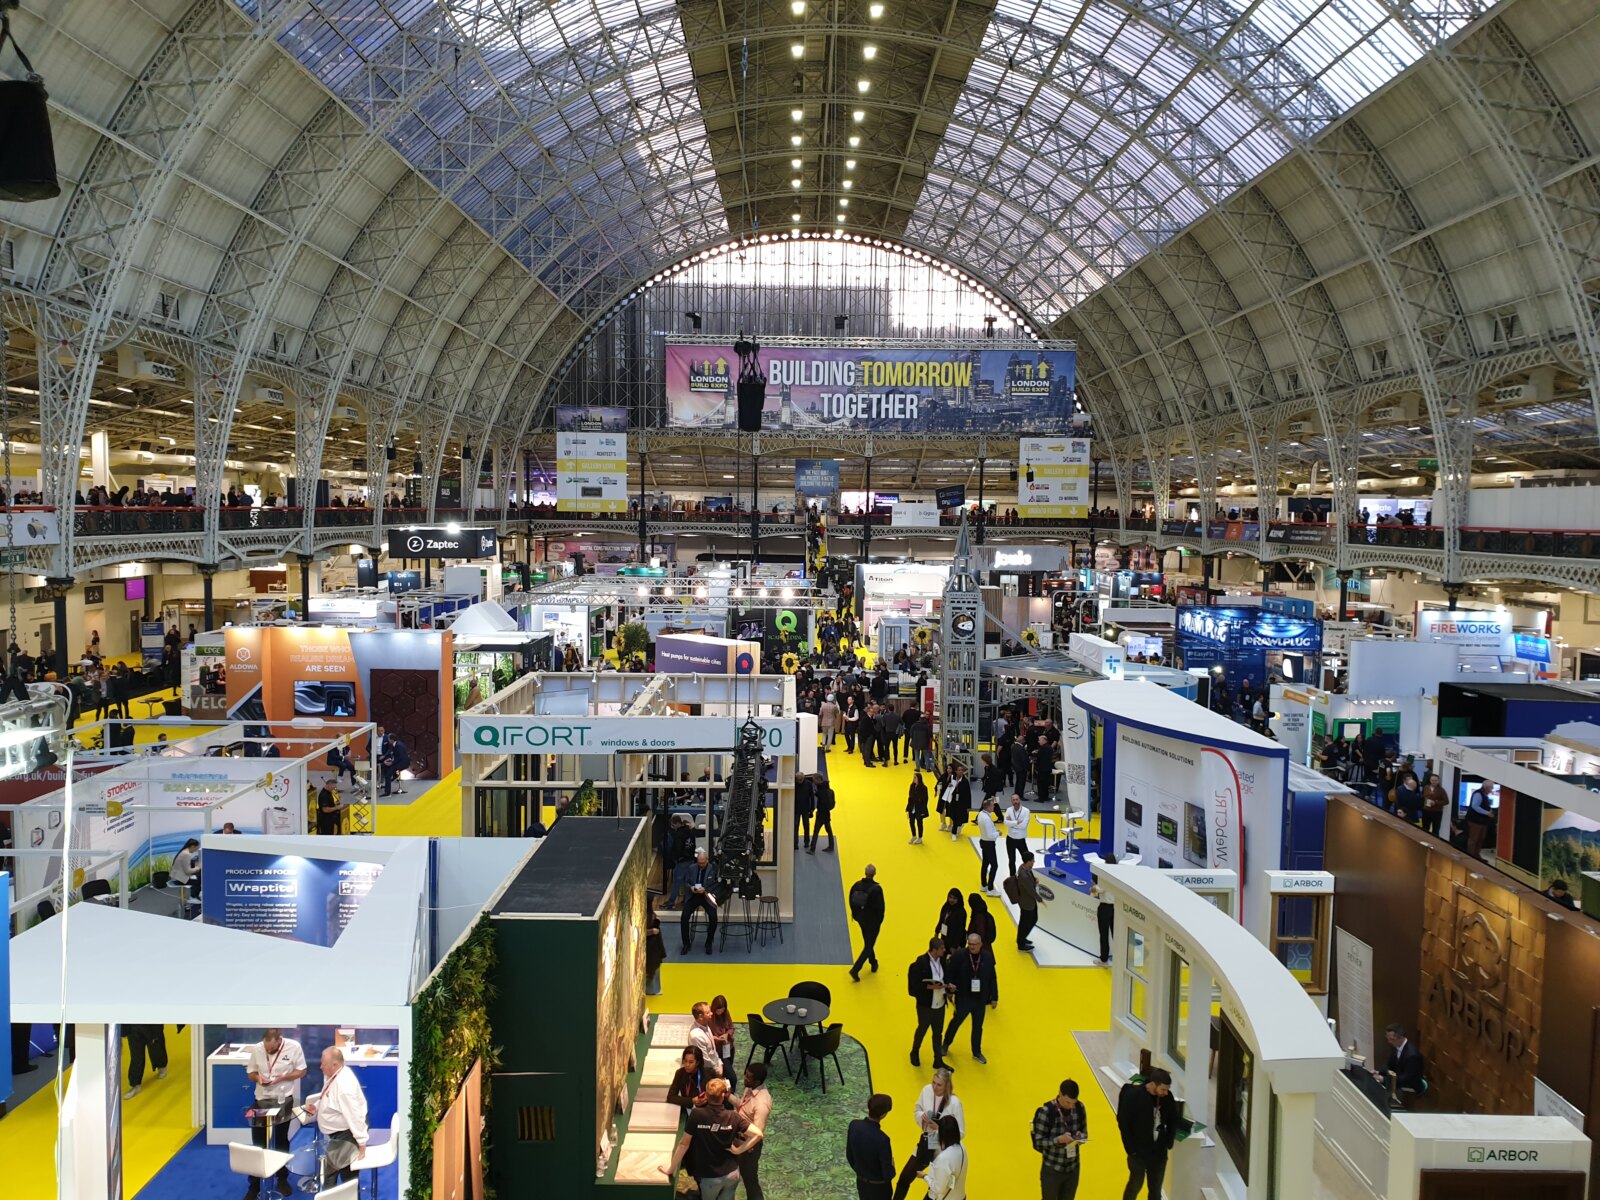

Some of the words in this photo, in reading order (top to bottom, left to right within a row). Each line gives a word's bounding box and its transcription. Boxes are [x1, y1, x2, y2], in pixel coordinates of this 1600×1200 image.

[769, 359, 856, 387] BUILDING
[860, 361, 973, 388] TOMORROW
[690, 375, 729, 383] LONDON
[820, 393, 918, 419] TOGETHER
[426, 540, 459, 550] Zaptec
[1430, 624, 1501, 634] FIREWORKS
[1253, 637, 1311, 646] RAWLPLUG
[324, 665, 346, 673] SEEN
[600, 738, 640, 746] windows
[642, 738, 648, 746] &
[650, 738, 676, 746] doors
[1122, 734, 1141, 747] BUILDING
[1140, 742, 1168, 757] AUTOMATION
[1168, 751, 1195, 767] SOLUTIONS
[1184, 876, 1214, 884] ARBOR
[1294, 879, 1323, 888] ARBOR
[228, 883, 294, 894] Wraptite
[1429, 972, 1530, 1065] ARBOR
[1486, 1149, 1538, 1162] ARBOR
